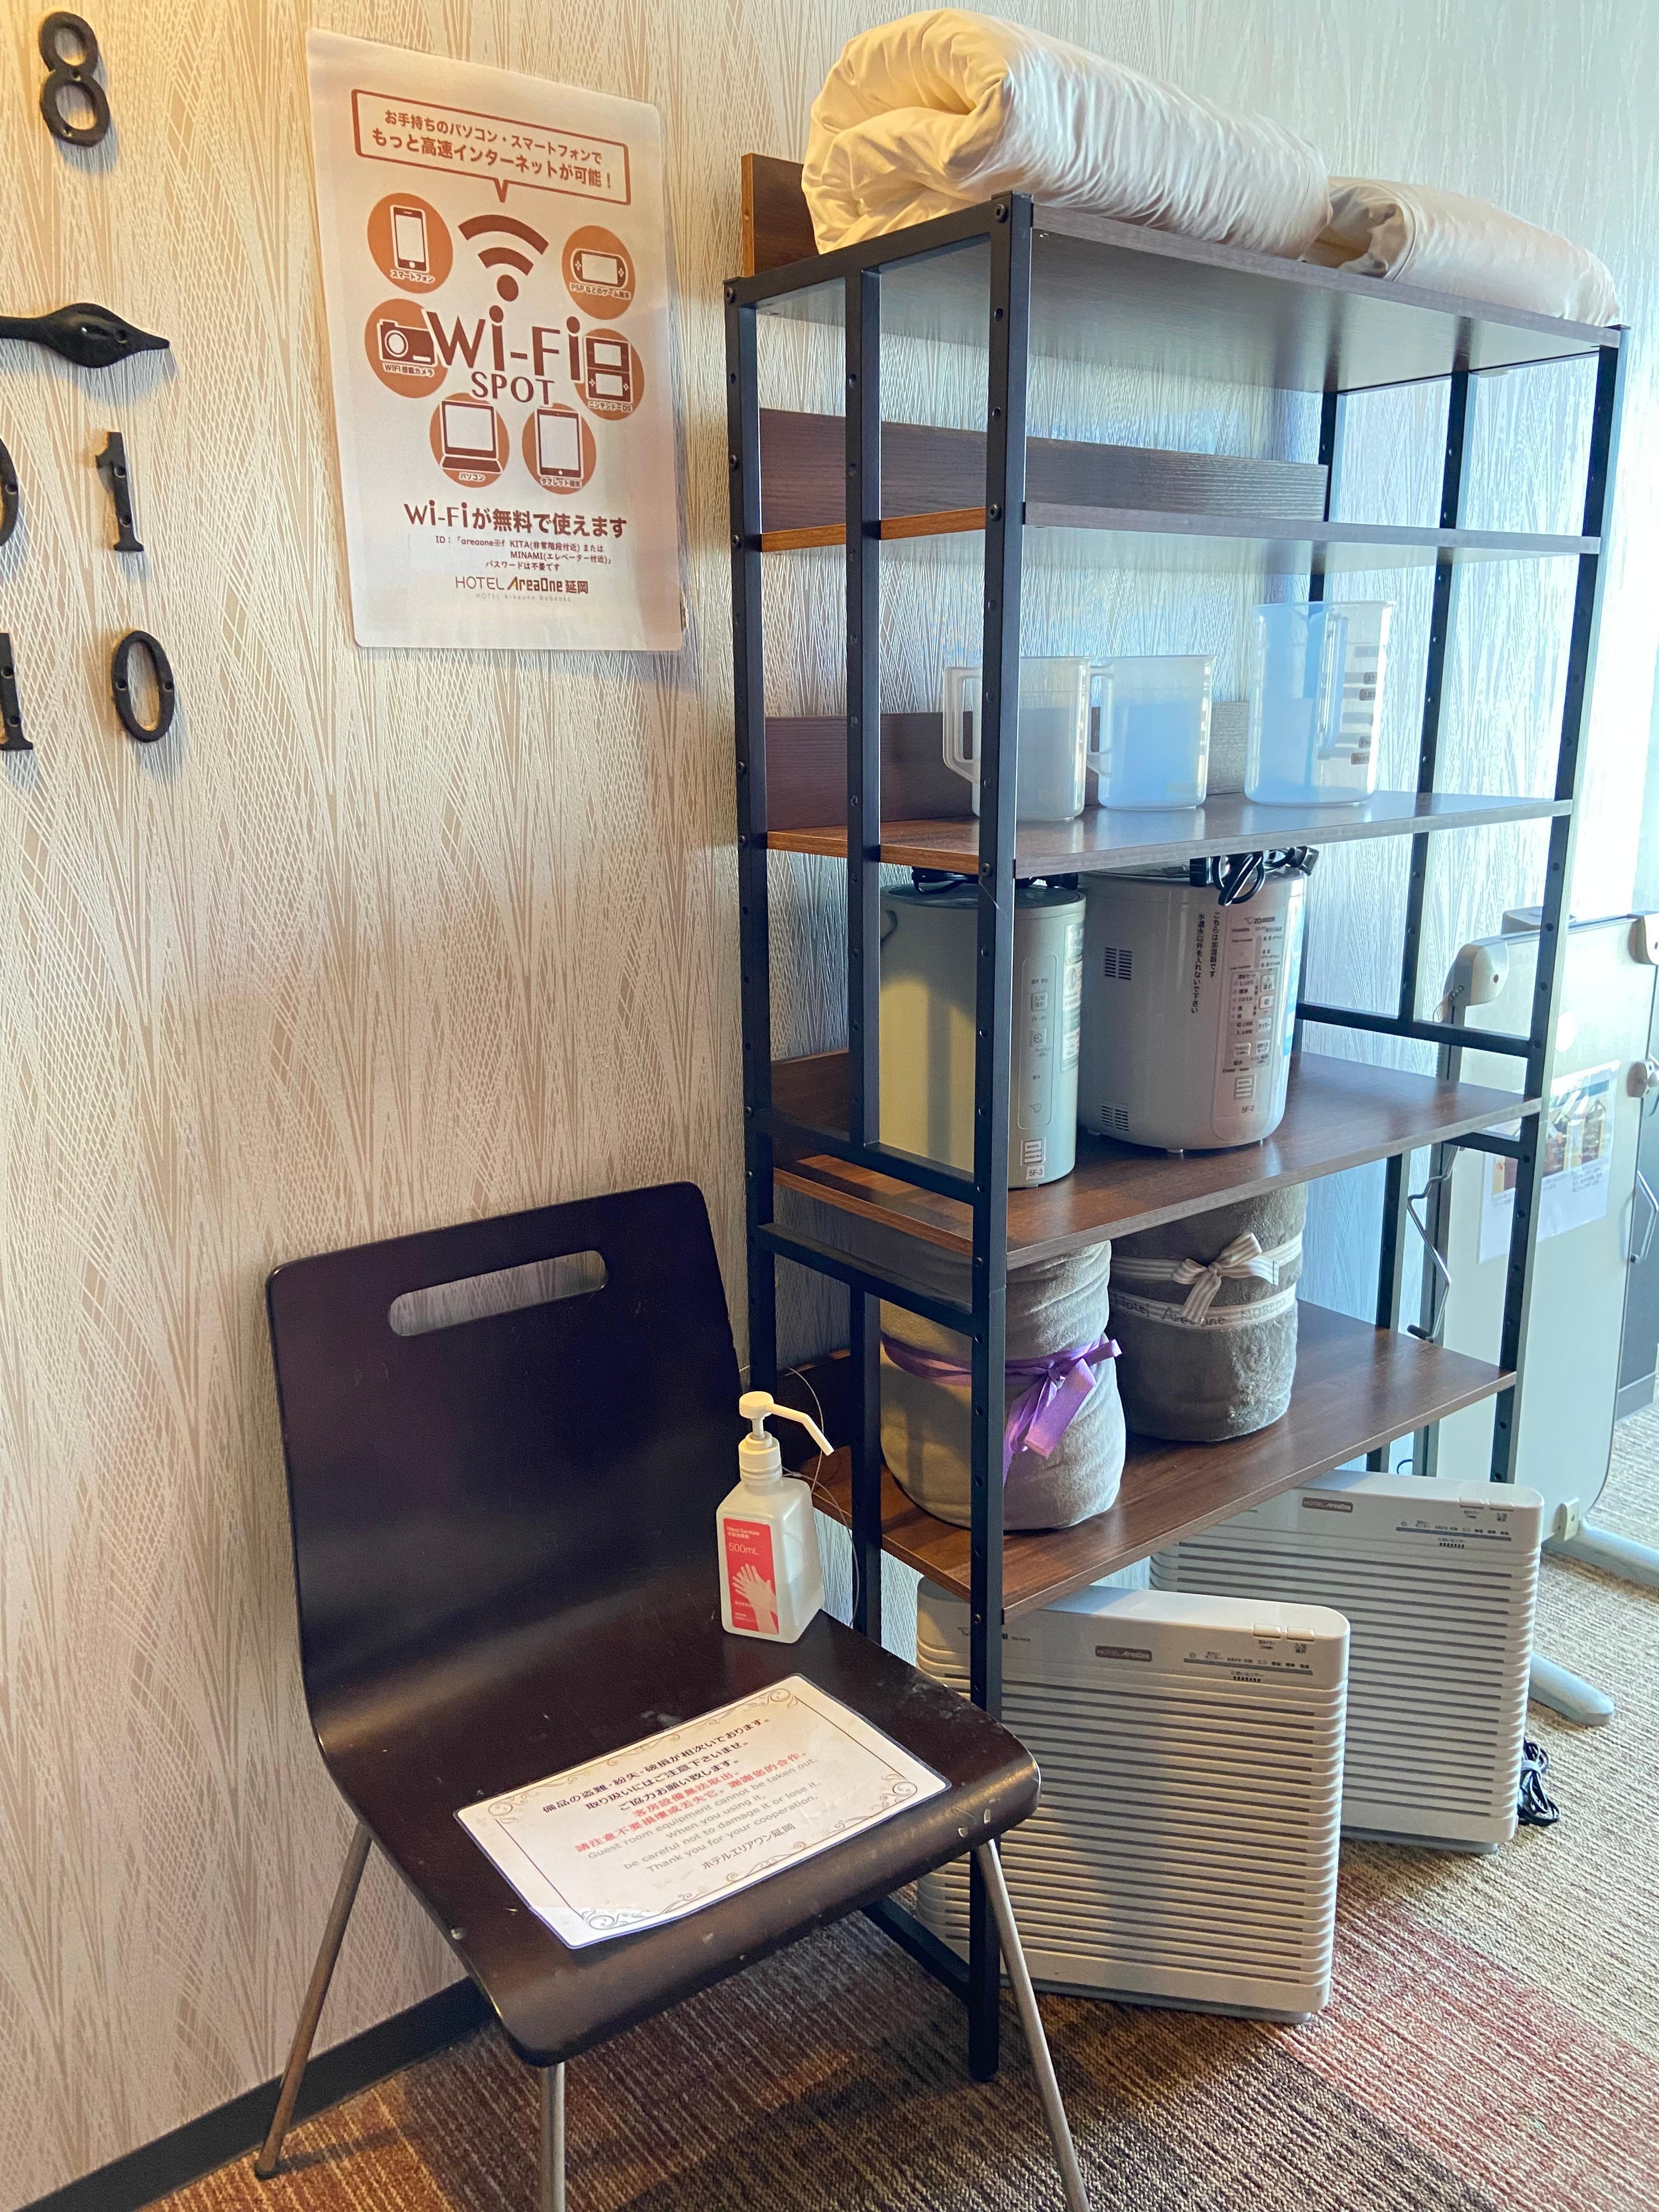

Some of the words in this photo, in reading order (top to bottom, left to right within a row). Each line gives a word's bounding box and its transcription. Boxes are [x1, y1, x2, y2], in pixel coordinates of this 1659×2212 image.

[39, 11, 110, 148] 8
[373, 128, 612, 189] もっと高速インターネットが可能！
[384, 110, 602, 165] お手持ちのパソコン・スマートフォンで
[392, 270, 434, 283] スマートフォン
[426, 305, 580, 381] Wi-Fi
[471, 371, 555, 405] SPOT
[460, 473, 484, 481] パソコン
[404, 499, 627, 539] Wi-Fiが無料で使えます
[486, 560, 560, 572] パスワードは不要です
[584, 544, 604, 552] または
[455, 575, 505, 590] HOTEL
[507, 575, 563, 592] AreaOne
[565, 580, 589, 594] 延岡
[1029, 1168, 1043, 1177] 5F-3
[728, 1542, 760, 1556] 500mL
[584, 1741, 749, 1810] 取り扱いにはご注意下さいませ。
[618, 1759, 740, 1811] ご協力お願い致します。
[588, 1842, 623, 1859] Guest
[624, 1830, 653, 1846] room
[656, 1804, 713, 1832] equipment
[714, 1788, 751, 1807] cannot
[751, 1781, 766, 1791] be
[766, 1768, 796, 1784] taken
[797, 1758, 818, 1770] out.
[623, 1860, 639, 1870] be
[641, 1842, 680, 1862] careful
[682, 1833, 702, 1844] not
[703, 1827, 715, 1836] to
[717, 1807, 761, 1830] damage
[763, 1802, 771, 1810] it
[772, 1797, 783, 1805] or
[785, 1786, 808, 1799] lose
[809, 1781, 822, 1789] it.
[666, 1822, 699, 1839] When
[699, 1812, 721, 1825] you
[723, 1798, 752, 1814] using
[646, 1853, 684, 1872] Thank
[685, 1844, 707, 1858] you
[707, 1837, 724, 1847] for
[726, 1823, 751, 1838] your
[754, 1795, 819, 1826] cooperation.
[702, 1822, 797, 1870] ホテルエリアワン延岡
